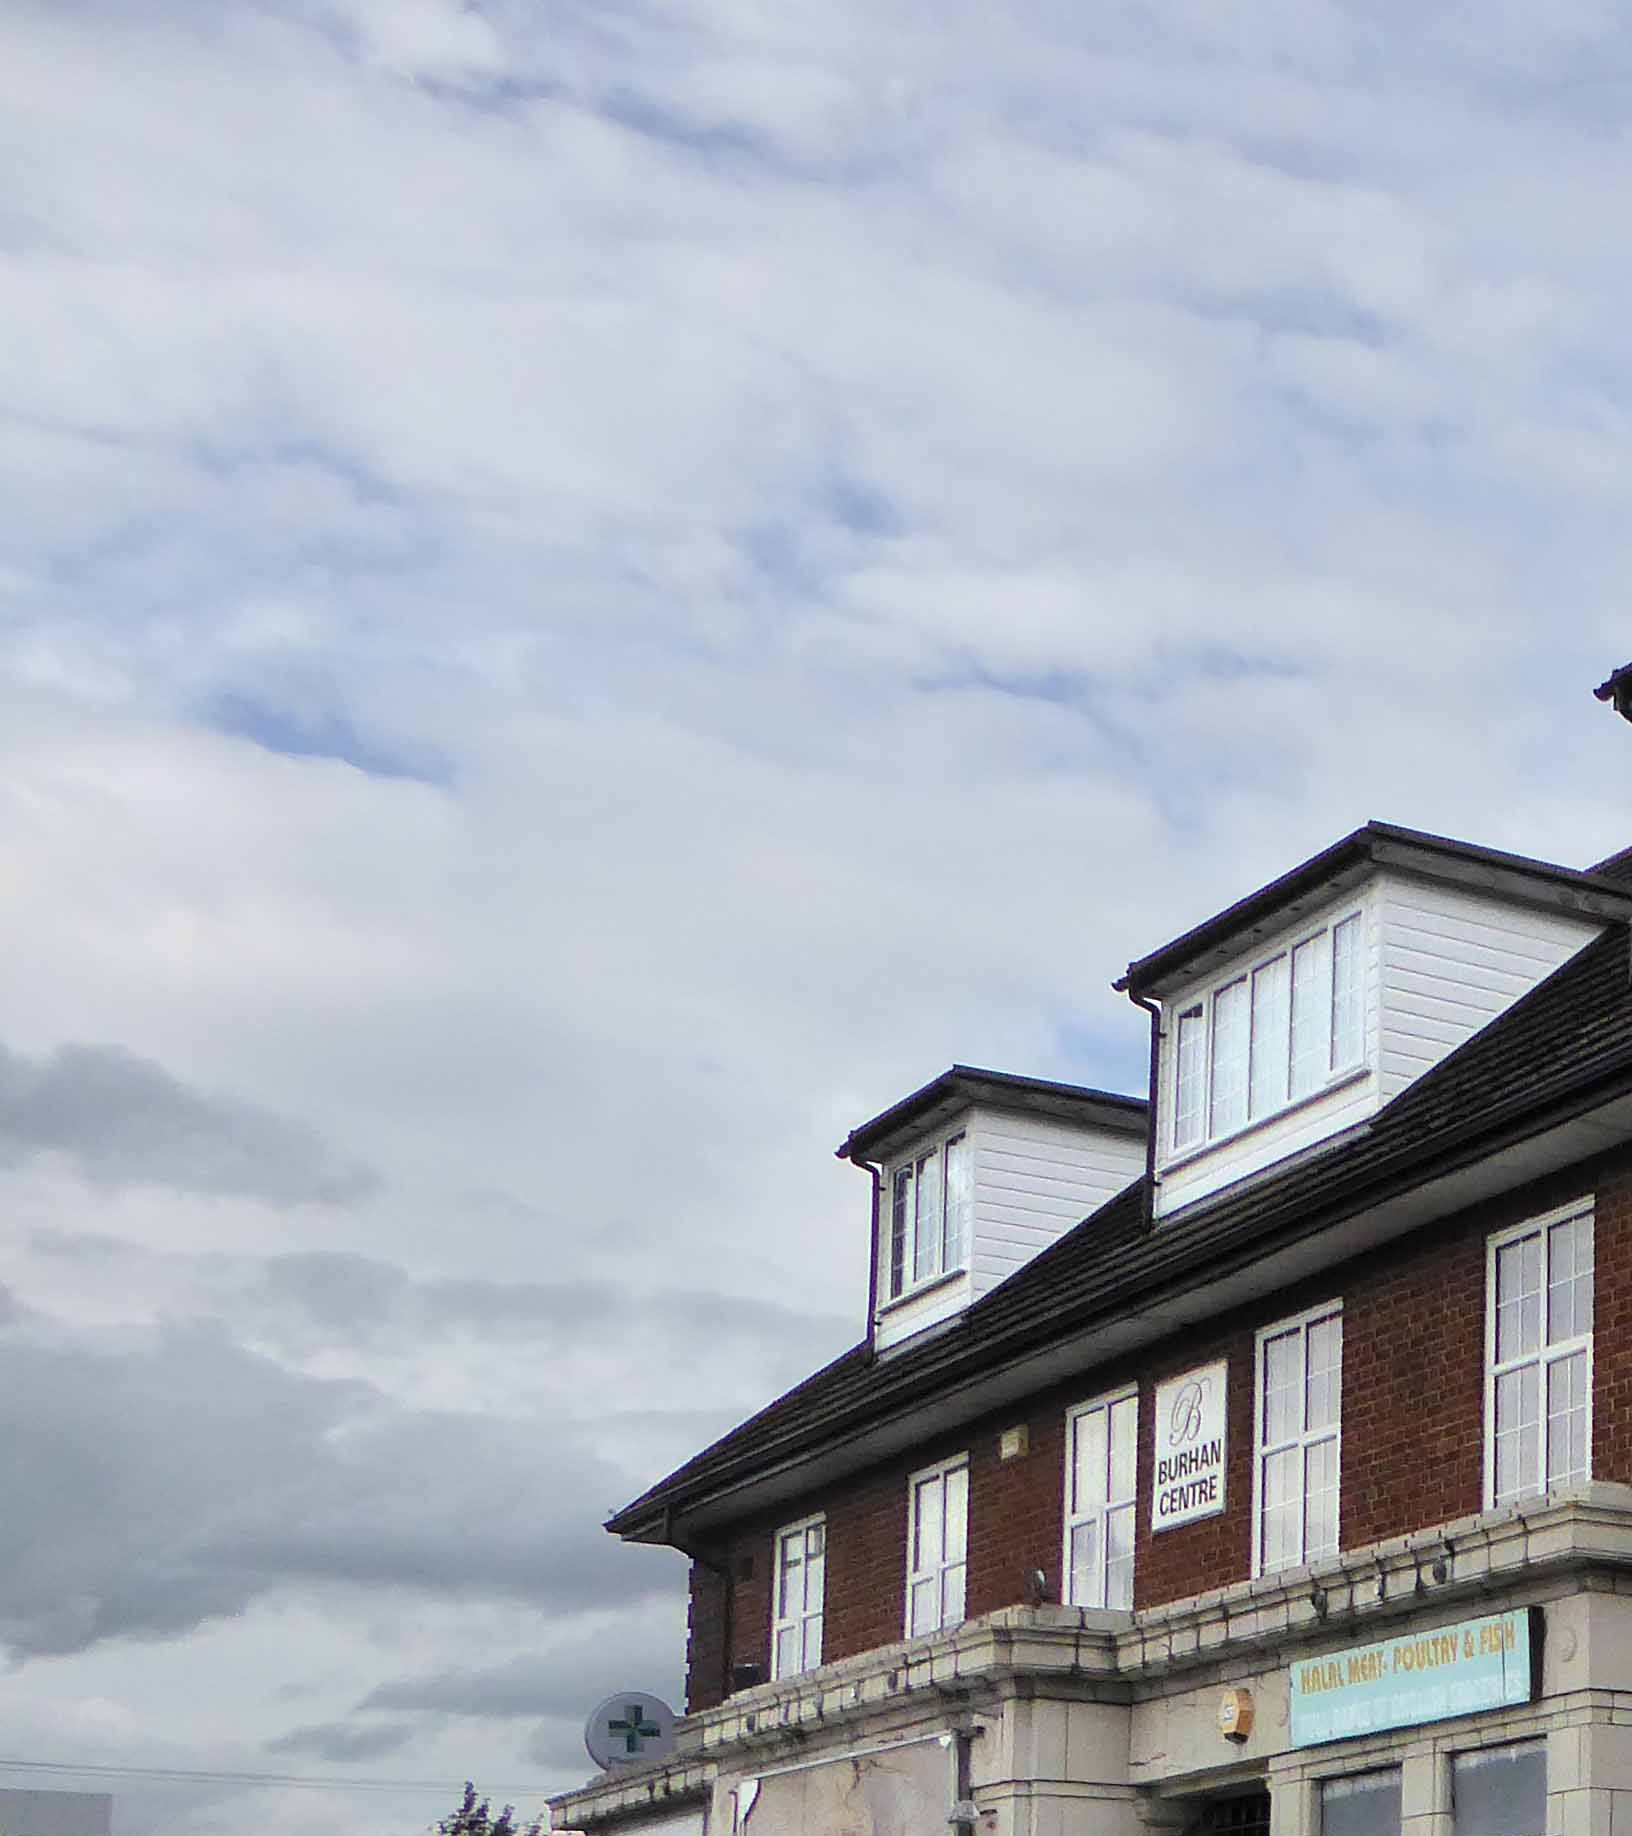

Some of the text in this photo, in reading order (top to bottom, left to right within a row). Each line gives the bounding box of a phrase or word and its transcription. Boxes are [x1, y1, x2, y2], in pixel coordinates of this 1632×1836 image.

[1158, 1438, 1222, 1486] BURHAN
[1159, 1474, 1218, 1517] CENTRE
[1301, 1661, 1345, 1696] HALAL
[1392, 1630, 1460, 1675] POULTRY
[1464, 1630, 1475, 1660] &
[1479, 1619, 1516, 1655] FISH
